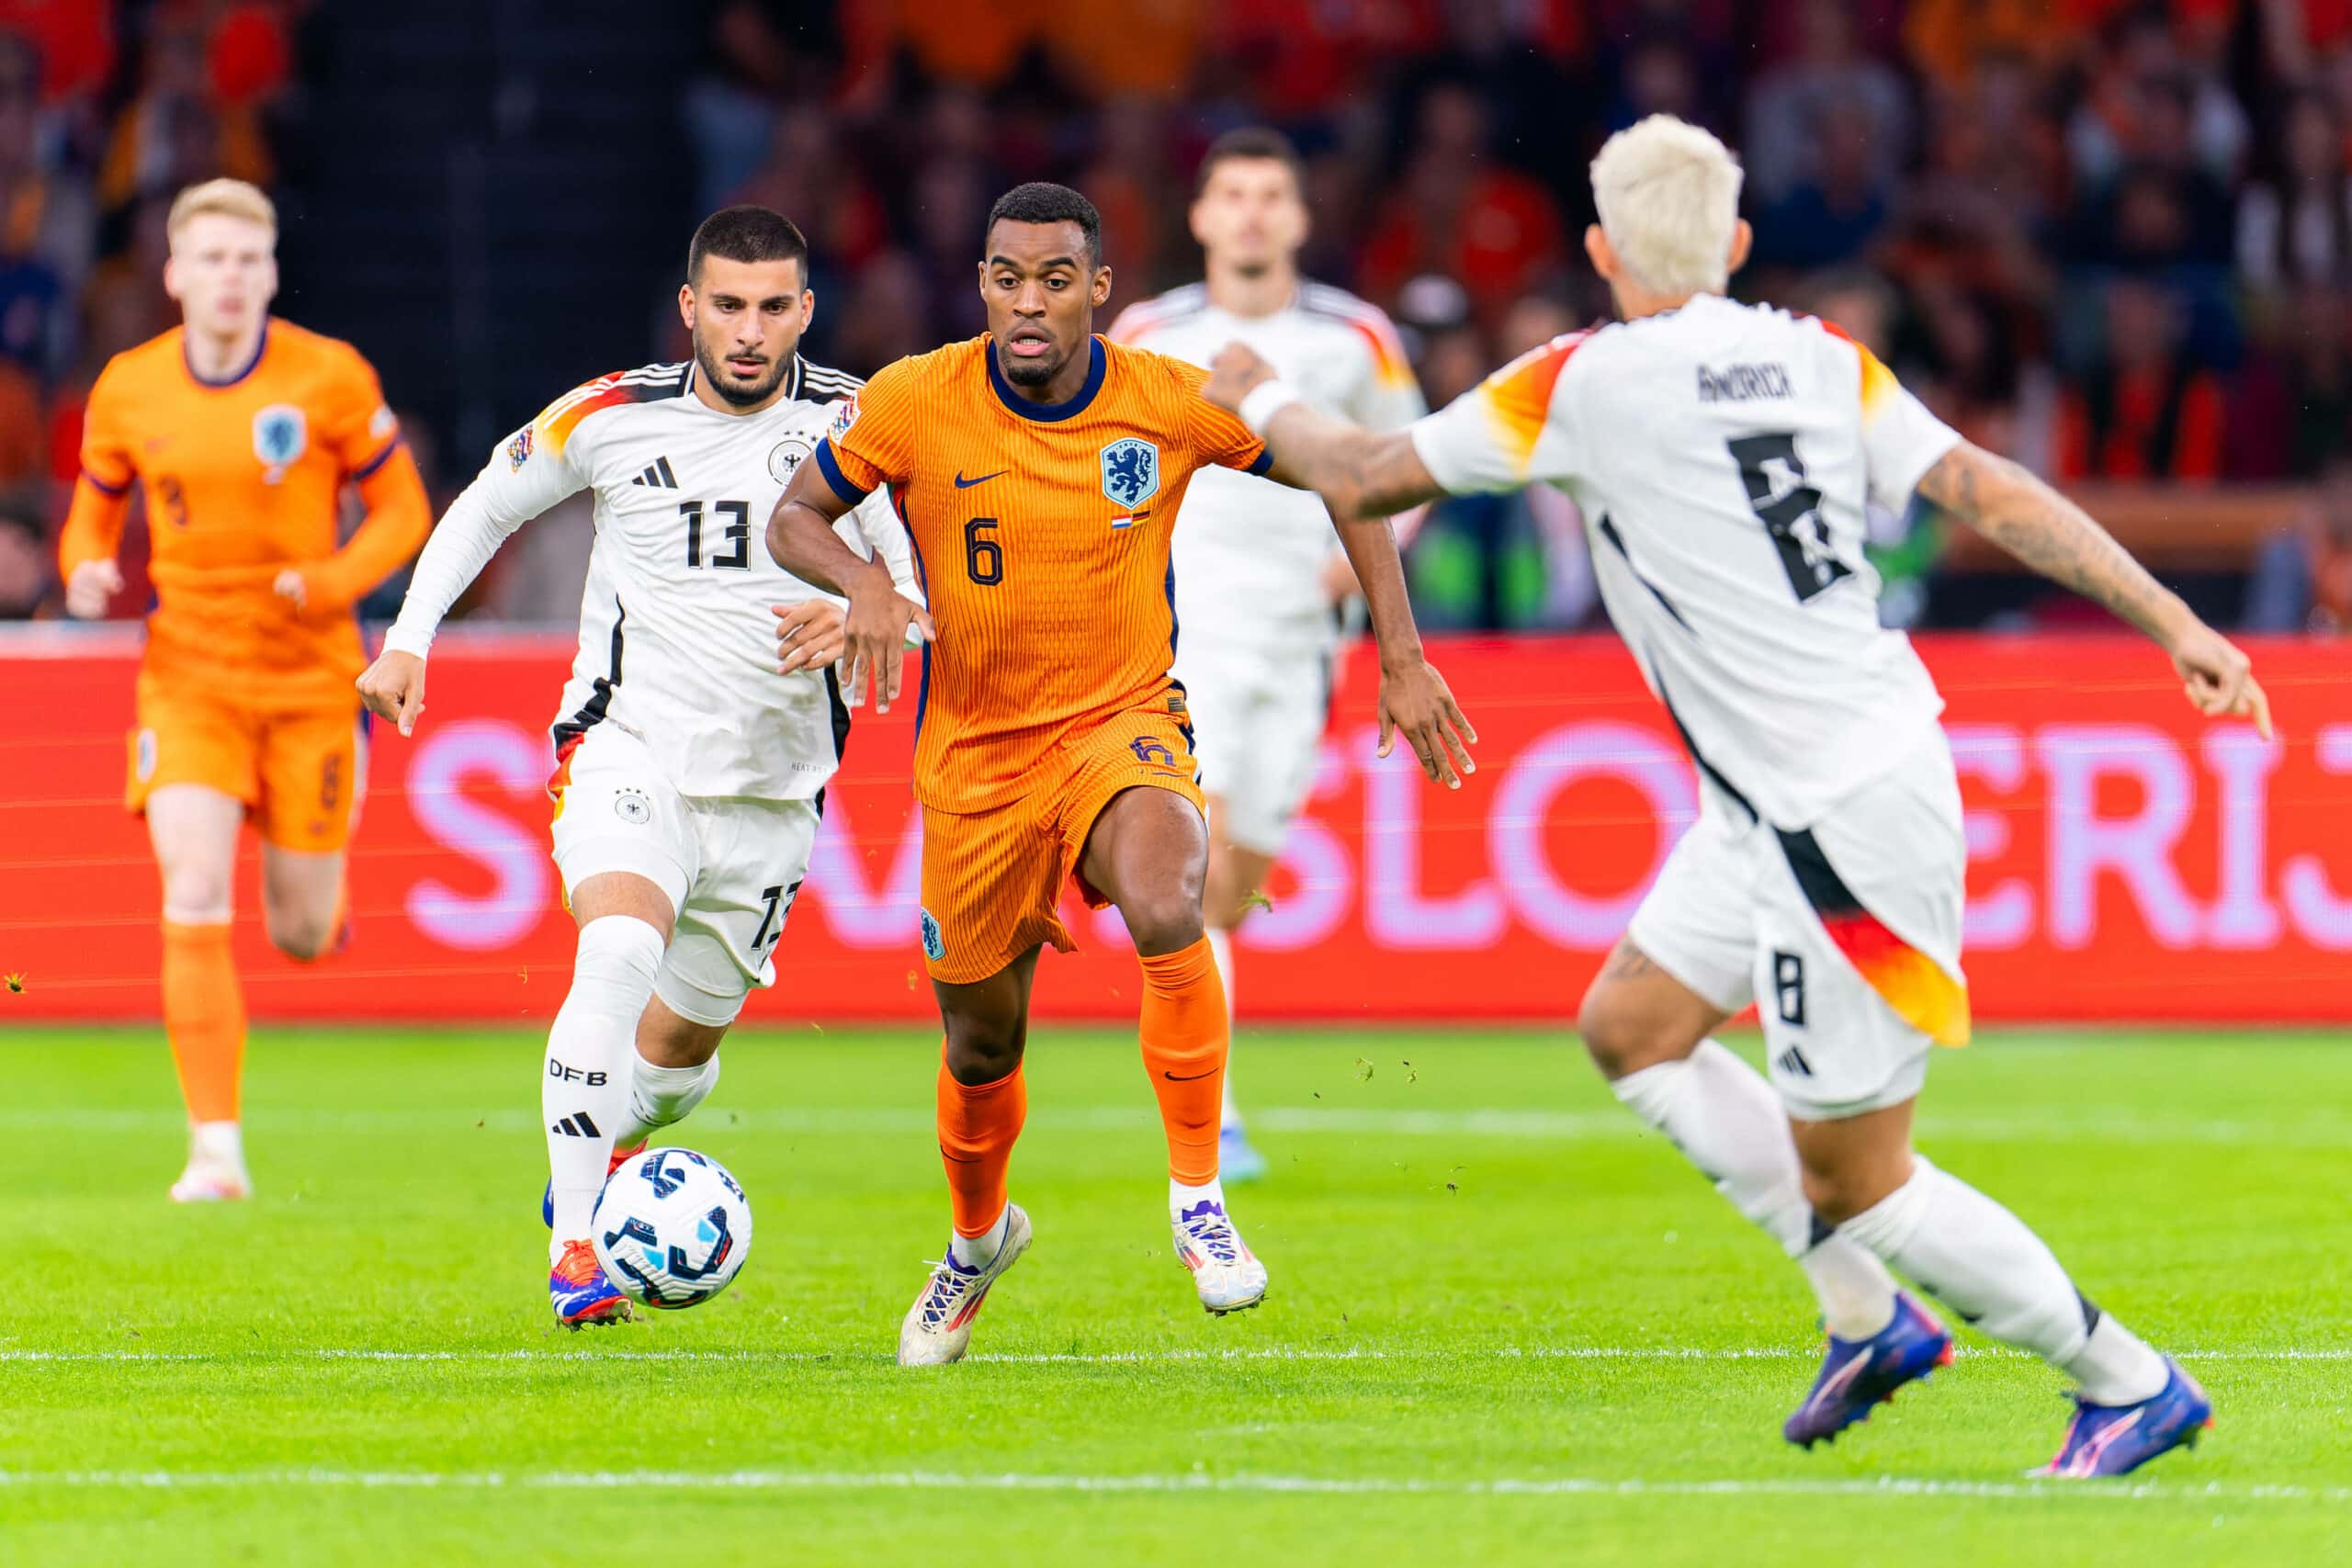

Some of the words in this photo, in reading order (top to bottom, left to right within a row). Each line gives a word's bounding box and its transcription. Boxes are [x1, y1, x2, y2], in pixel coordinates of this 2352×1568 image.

[679, 500, 752, 571] 13
[965, 517, 1003, 586] 6
[1773, 948, 1805, 1027] 8
[549, 1057, 607, 1087] DFB
